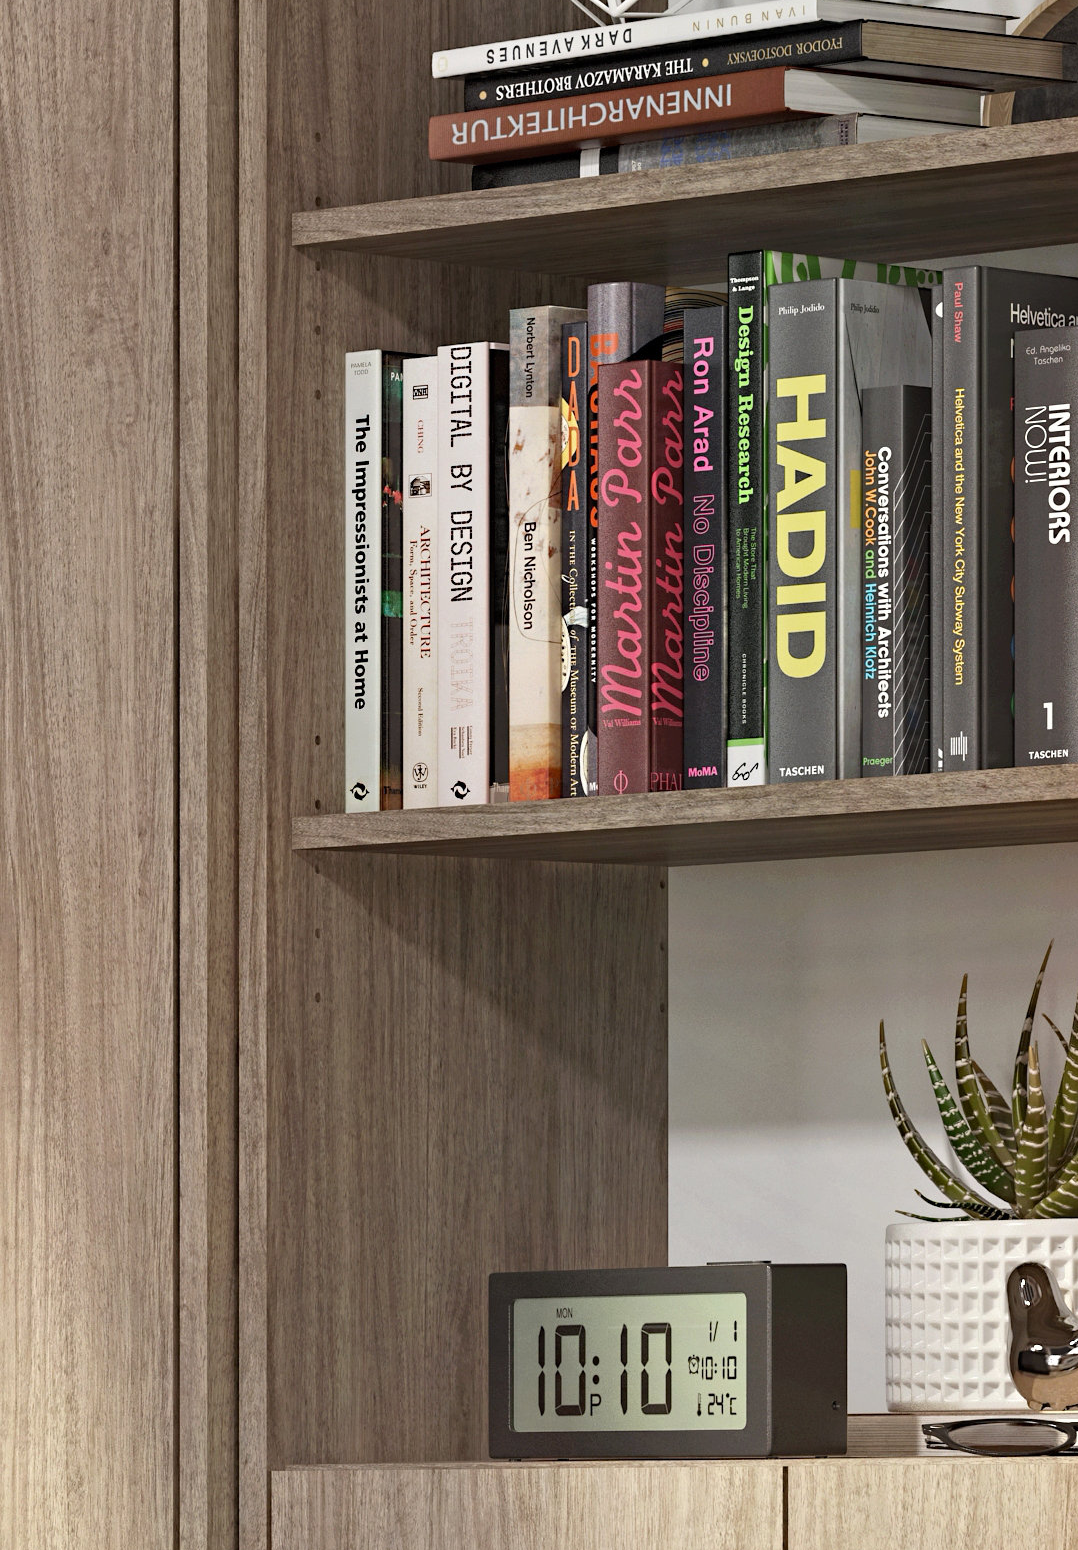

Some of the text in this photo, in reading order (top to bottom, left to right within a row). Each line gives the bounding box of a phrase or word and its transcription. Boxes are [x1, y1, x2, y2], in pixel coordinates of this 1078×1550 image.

[692, 4, 806, 32] IVAN BUNIN
[486, 27, 633, 65] DARK AVENUES
[726, 36, 844, 66] FYODOR DOSTOEVSKY
[495, 57, 694, 101] THE KARAMAZOV BROTHERS
[451, 82, 733, 146] INNENARCHITEKTUR
[778, 305, 799, 317] Philip
[954, 281, 964, 344] Paul Shaw
[1010, 302, 1066, 328] Helvetica
[350, 361, 372, 370] PAMELA
[525, 316, 536, 398] Norbert Lynton
[567, 336, 581, 512] DADA
[692, 336, 715, 473] Ron Arad
[734, 304, 754, 505] Design Research
[601, 368, 643, 508] Parr
[651, 369, 684, 506] Parr
[449, 346, 474, 603] DIGITAL BY DESIGN
[864, 450, 877, 487] John
[1048, 403, 1071, 545] INTERIORS
[569, 530, 576, 543] IN
[736, 527, 742, 536] to
[776, 373, 827, 680] HADID
[953, 387, 966, 686] Helvetica and the New York City Subway System
[351, 413, 371, 711] The Impressionists at Home
[408, 539, 417, 568] Form,
[523, 520, 537, 631] Ben Nicholson
[589, 537, 598, 598] WORKSHOPS
[741, 527, 750, 609] Brought Modern Living
[750, 527, 758, 580] The Store That
[864, 549, 877, 580] and
[408, 569, 417, 598] Space,
[420, 524, 432, 660] ARCHITECTURE
[688, 493, 715, 683] No Discipline
[877, 446, 892, 719] Conversations with Architects
[600, 520, 643, 717] Martin
[651, 521, 684, 718] Martin
[864, 582, 877, 642] Heinrich
[570, 628, 579, 642] of
[449, 616, 475, 712] TROIKA
[864, 645, 877, 681] Klotz
[570, 669, 579, 715] Museum
[570, 717, 577, 730] OF
[614, 717, 642, 728] Williams
[1043, 702, 1053, 730] 1
[569, 733, 579, 776] Modern
[688, 766, 719, 778] MoMA
[779, 765, 825, 777] TASCHEN
[862, 756, 893, 767] Praeger
[1028, 749, 1069, 760] TASCHEN
[569, 777, 577, 797] Art
[556, 1307, 574, 1319] MON
[537, 1322, 673, 1417] 10:10
[700, 1355, 738, 1381] 10:10
[589, 1393, 603, 1418] P
